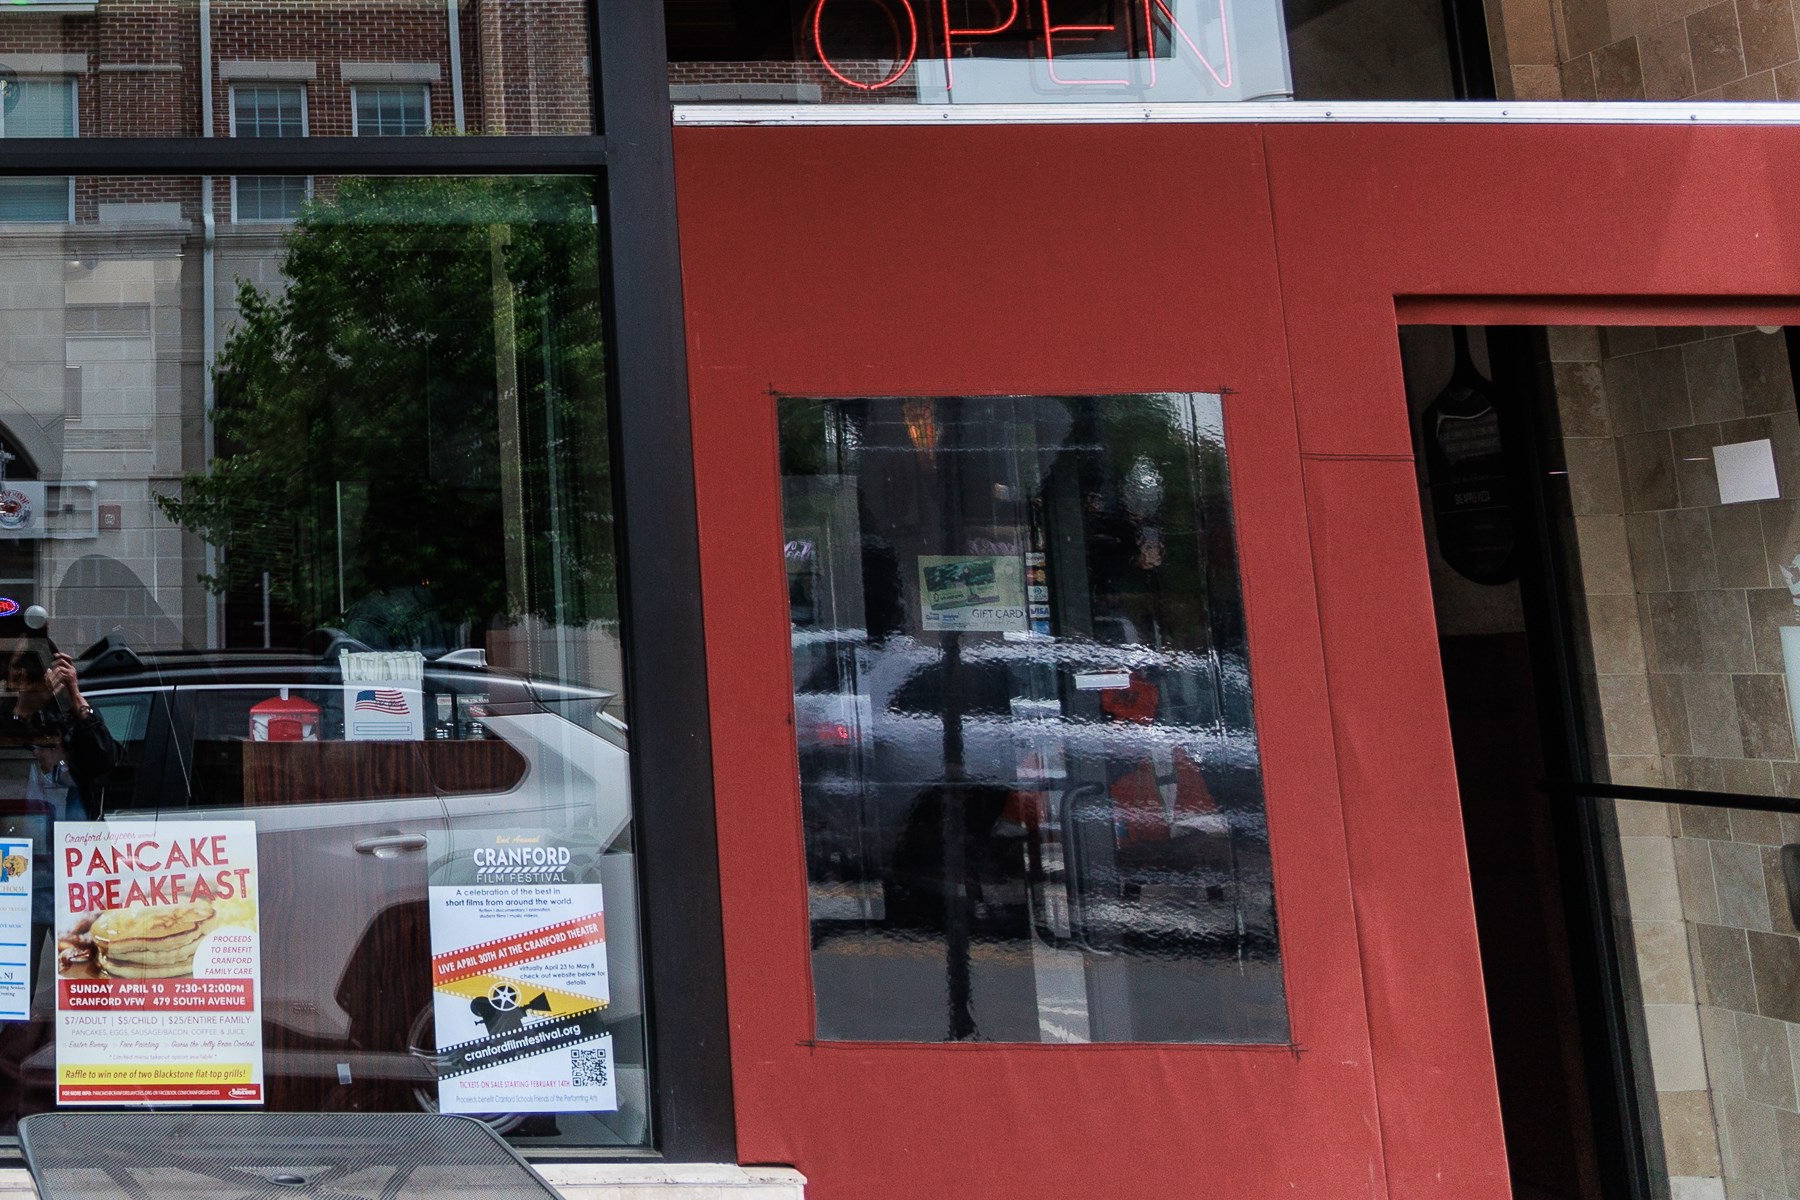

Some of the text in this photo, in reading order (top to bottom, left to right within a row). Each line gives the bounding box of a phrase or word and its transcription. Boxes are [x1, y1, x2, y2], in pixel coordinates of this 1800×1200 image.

[972, 608, 993, 619] GIFT
[995, 608, 1024, 619] CARD
[65, 832, 102, 846] Cranford
[102, 832, 136, 844] Jaycees
[513, 835, 540, 844] Annual
[65, 835, 229, 877] PANCAKE
[473, 847, 571, 867] CRANFORD
[476, 872, 567, 884] FILM FESTIVAL
[67, 868, 250, 913] BREAKFAST
[464, 888, 509, 896] celebration
[550, 898, 574, 906] world.
[213, 935, 252, 943] PROCEEDS
[211, 946, 252, 954] TO BENEFIT
[438, 923, 599, 975] LIVE APRIL 30TH AT THE CRANFORD THEATER
[211, 957, 253, 965] CRANFORD
[519, 965, 543, 973] virtually
[544, 964, 558, 972] April
[3, 971, 14, 980] NJ
[70, 984, 245, 994] SUNDAY APRIL 10 7:30-12:00PM
[69, 997, 246, 1006] CRANFORD VFW 479 SOUTH AVENUE
[64, 1016, 252, 1026] $7/ADULT $5/CHILD $25/ENTIRE FAMILY
[68, 1041, 88, 1050] Easter
[89, 1041, 108, 1050] Bunny
[119, 1041, 135, 1050] Face
[135, 1041, 160, 1050] Painting
[464, 1024, 581, 1062] cranfordfilmfestival.org
[65, 1069, 246, 1080] Raffle to win one of two Blackstone flat-top grills!
[459, 1080, 571, 1089] TICKETS ON SALE STARTING FEBRUARY 14TH
[456, 1095, 477, 1103] Proceeds
[478, 1095, 495, 1103] benefit
[495, 1095, 515, 1103] Cranford
